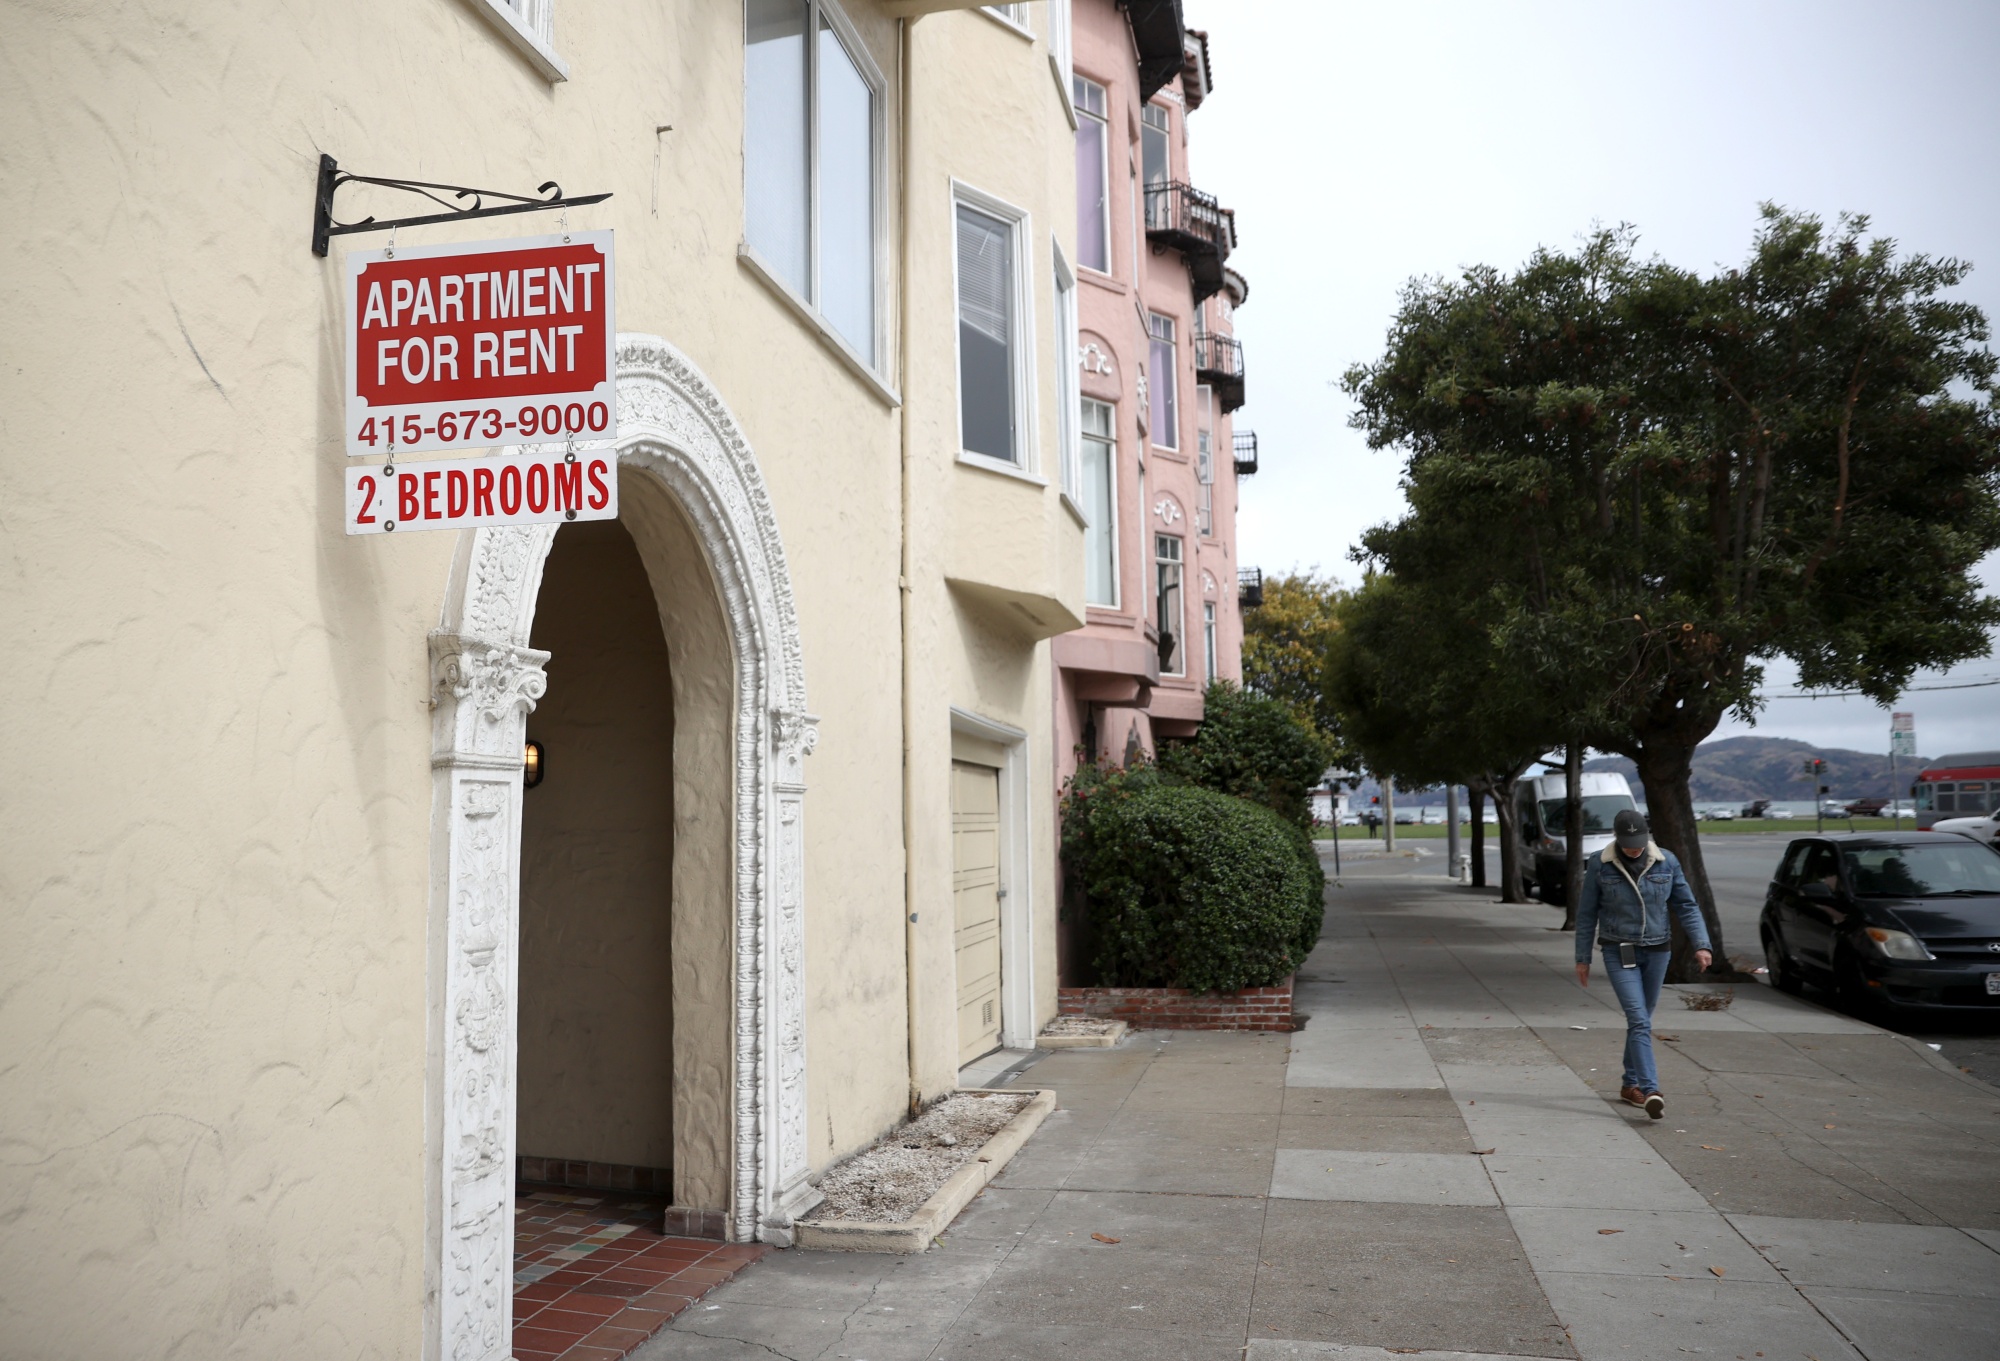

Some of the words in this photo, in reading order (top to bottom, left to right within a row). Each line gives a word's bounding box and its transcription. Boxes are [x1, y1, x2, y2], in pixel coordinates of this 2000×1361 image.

[362, 263, 600, 329] APARTMENT
[377, 335, 459, 386] FOR
[474, 325, 583, 379] RENT
[358, 402, 609, 446] 415-673-9000
[357, 476, 376, 524] 2
[399, 460, 609, 521] BEDROOMS
